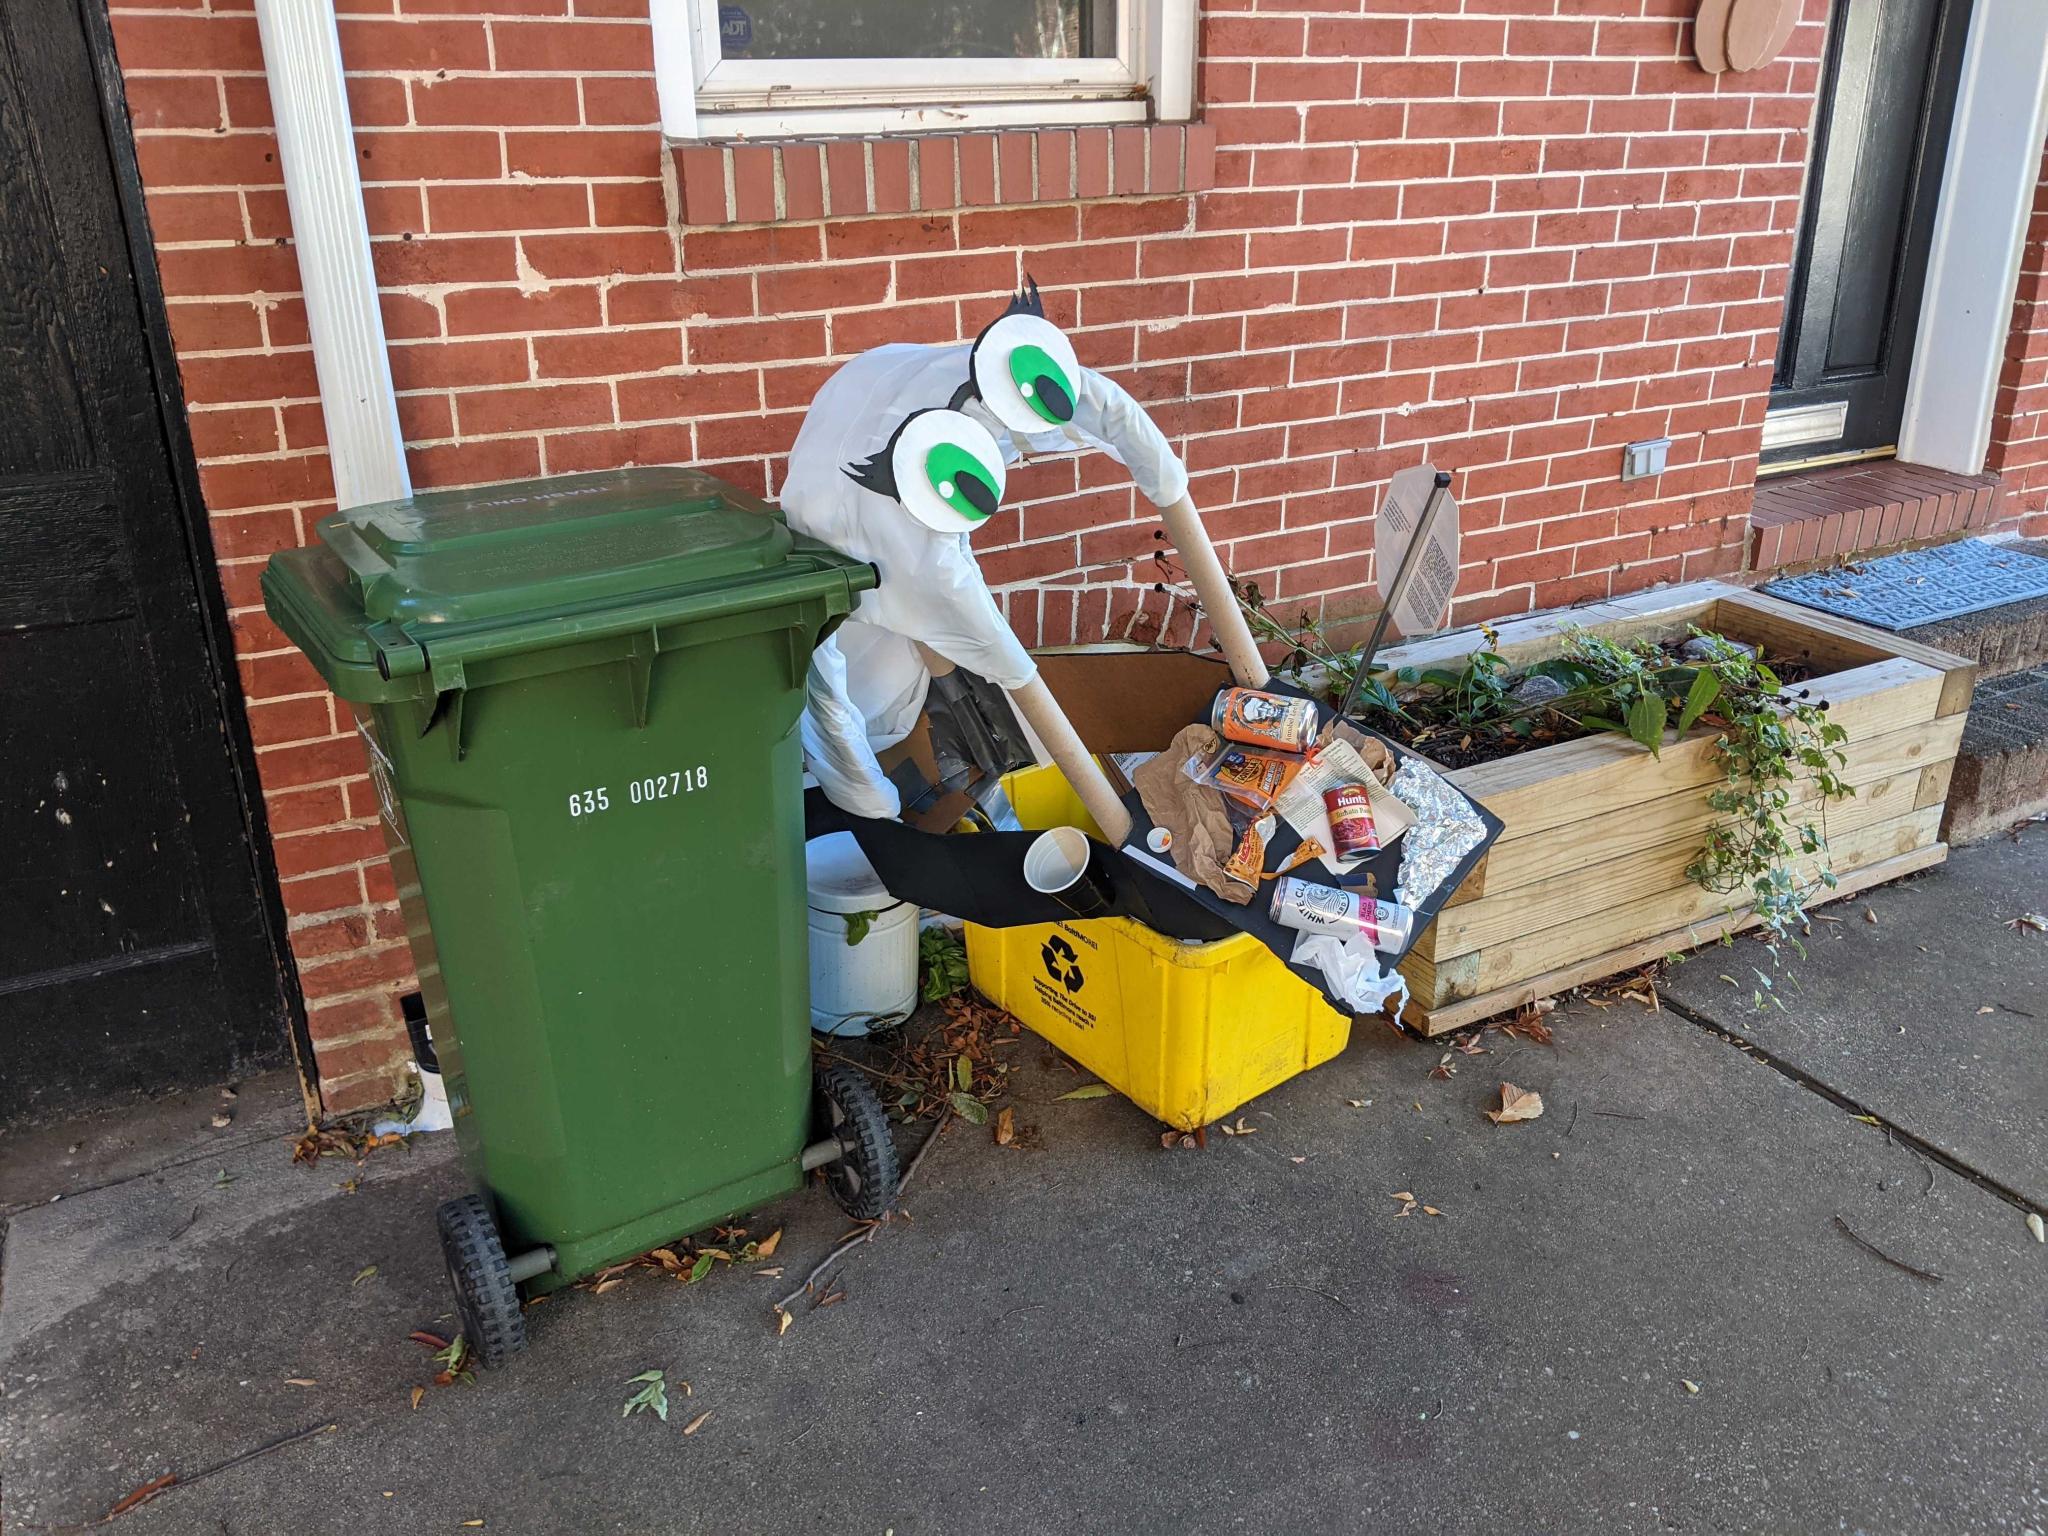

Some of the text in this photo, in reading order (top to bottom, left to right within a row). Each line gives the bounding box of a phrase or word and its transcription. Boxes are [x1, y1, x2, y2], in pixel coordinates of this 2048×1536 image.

[722, 20, 747, 36] ADT
[533, 486, 609, 500] TRASH
[1285, 717, 1295, 742] Annabel
[569, 766, 708, 817] 635 002718
[1296, 900, 1325, 924] WHITE
[1060, 992, 1068, 1003] The
